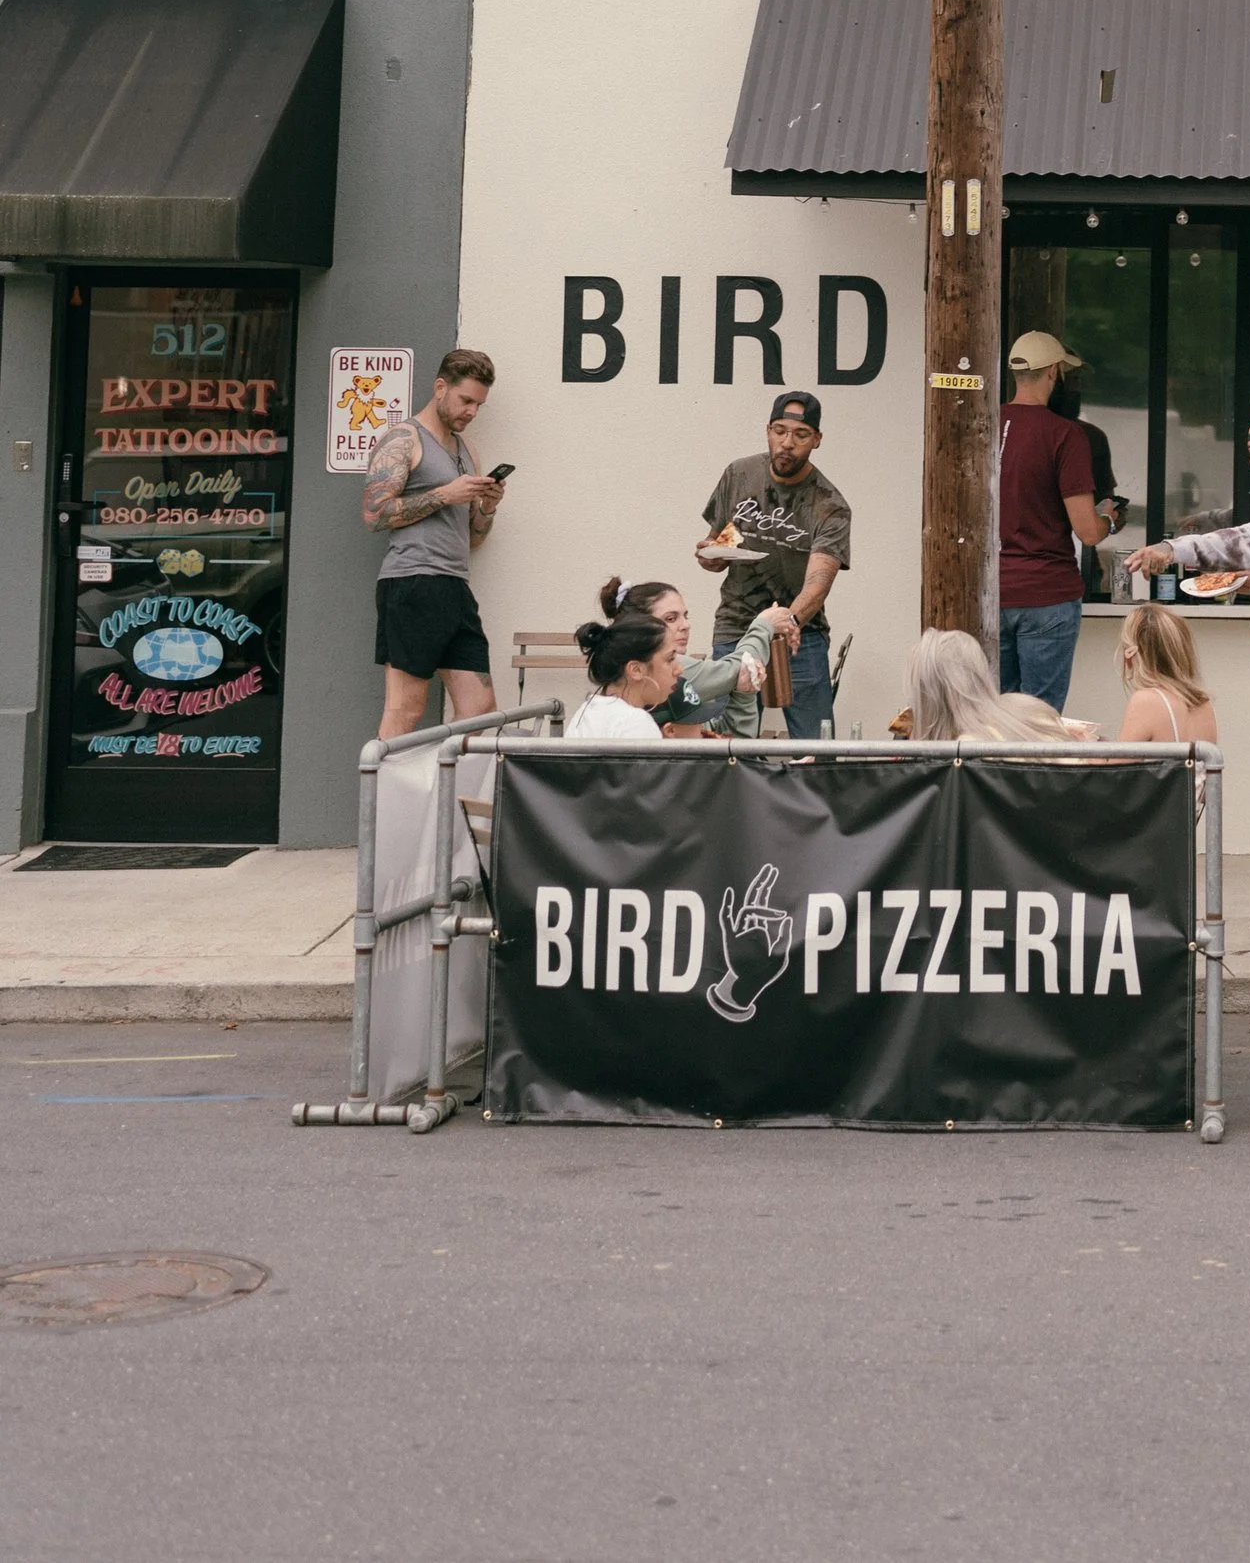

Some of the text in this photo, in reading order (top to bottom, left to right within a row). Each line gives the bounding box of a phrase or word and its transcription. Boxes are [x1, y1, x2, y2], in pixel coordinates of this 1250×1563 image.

[151, 324, 226, 356] 512
[561, 274, 888, 386] BIRD
[340, 356, 403, 371] BE KIND
[100, 378, 276, 415] EXPERT
[940, 377, 980, 388] 190F28
[94, 428, 279, 455] TATTOOING
[336, 452, 364, 461] DON'T
[124, 469, 243, 506] Open Daily
[100, 507, 266, 526] 980-256-4750
[99, 596, 263, 648] COAST TO COAST
[98, 666, 263, 716] ALL ARE WELCOME
[88, 734, 262, 756] MUST BE 18 TO ENTER
[534, 886, 1142, 996] BIRD PIZZERIA
